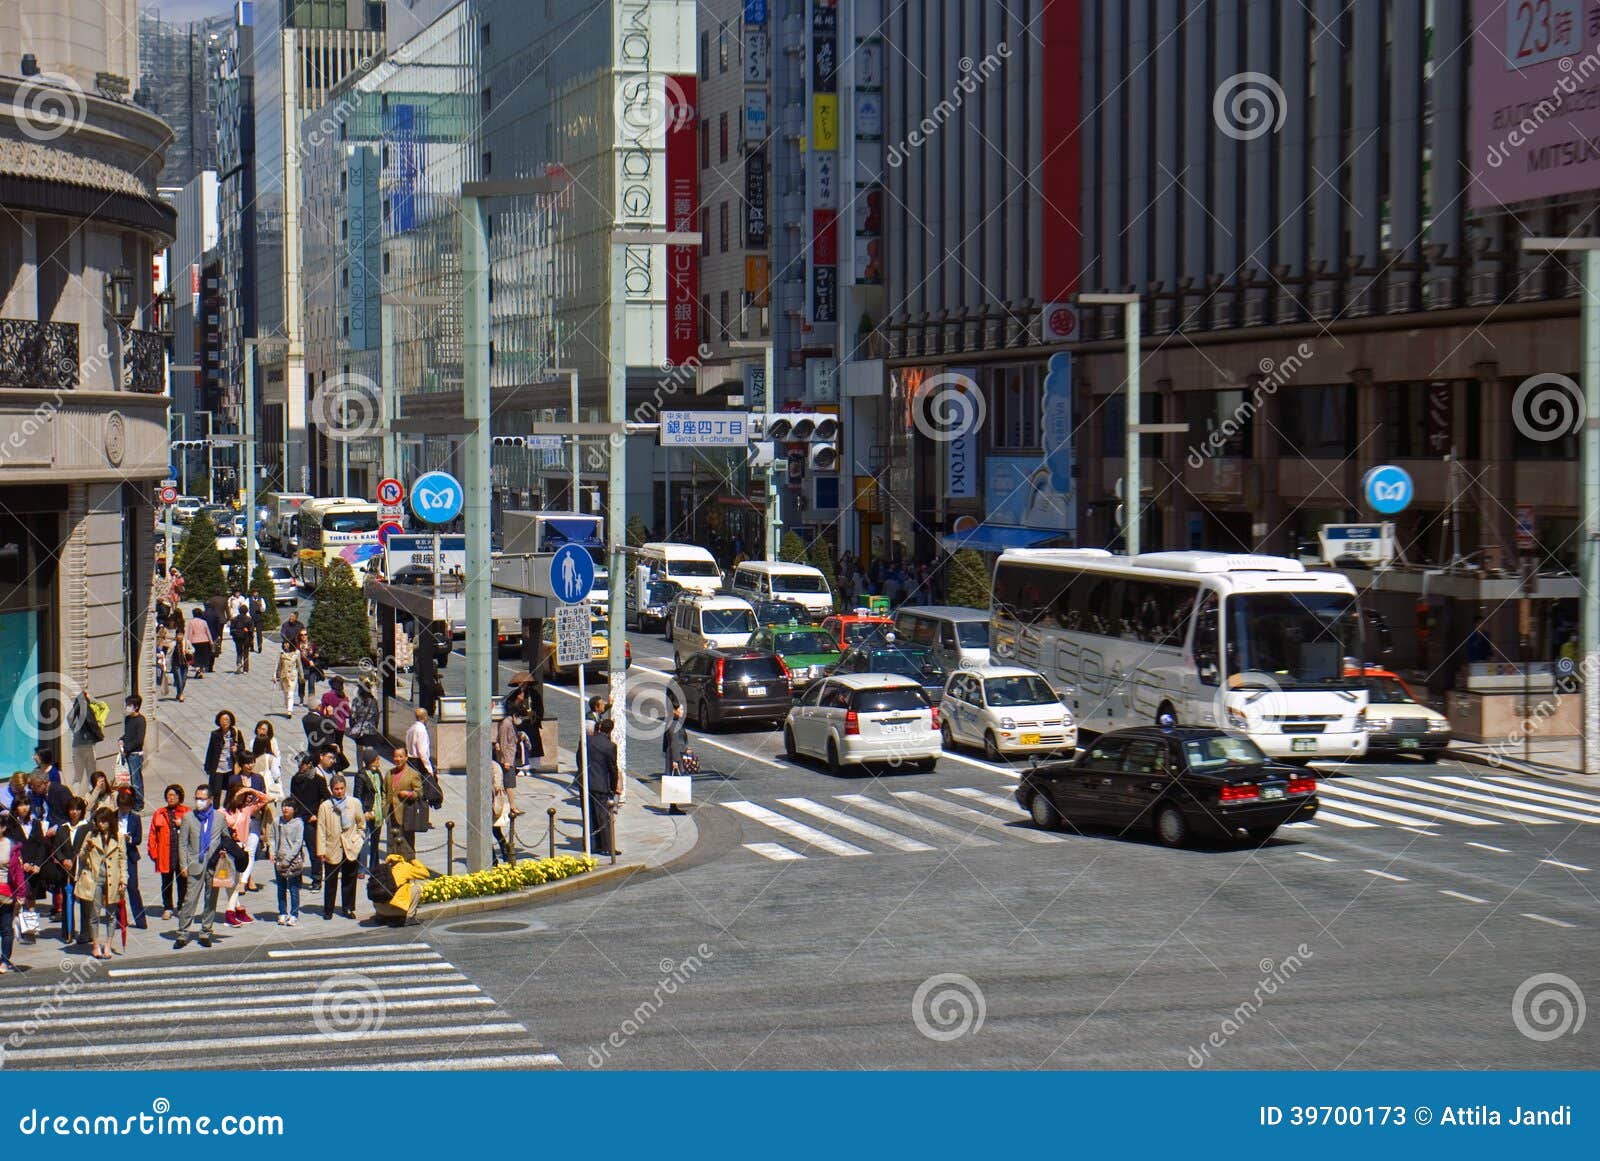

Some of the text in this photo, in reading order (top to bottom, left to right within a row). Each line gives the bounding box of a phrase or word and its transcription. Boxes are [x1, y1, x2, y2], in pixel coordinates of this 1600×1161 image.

[666, 420, 742, 435] 銀座四丁目
[674, 434, 735, 442] Ginza 4-chome
